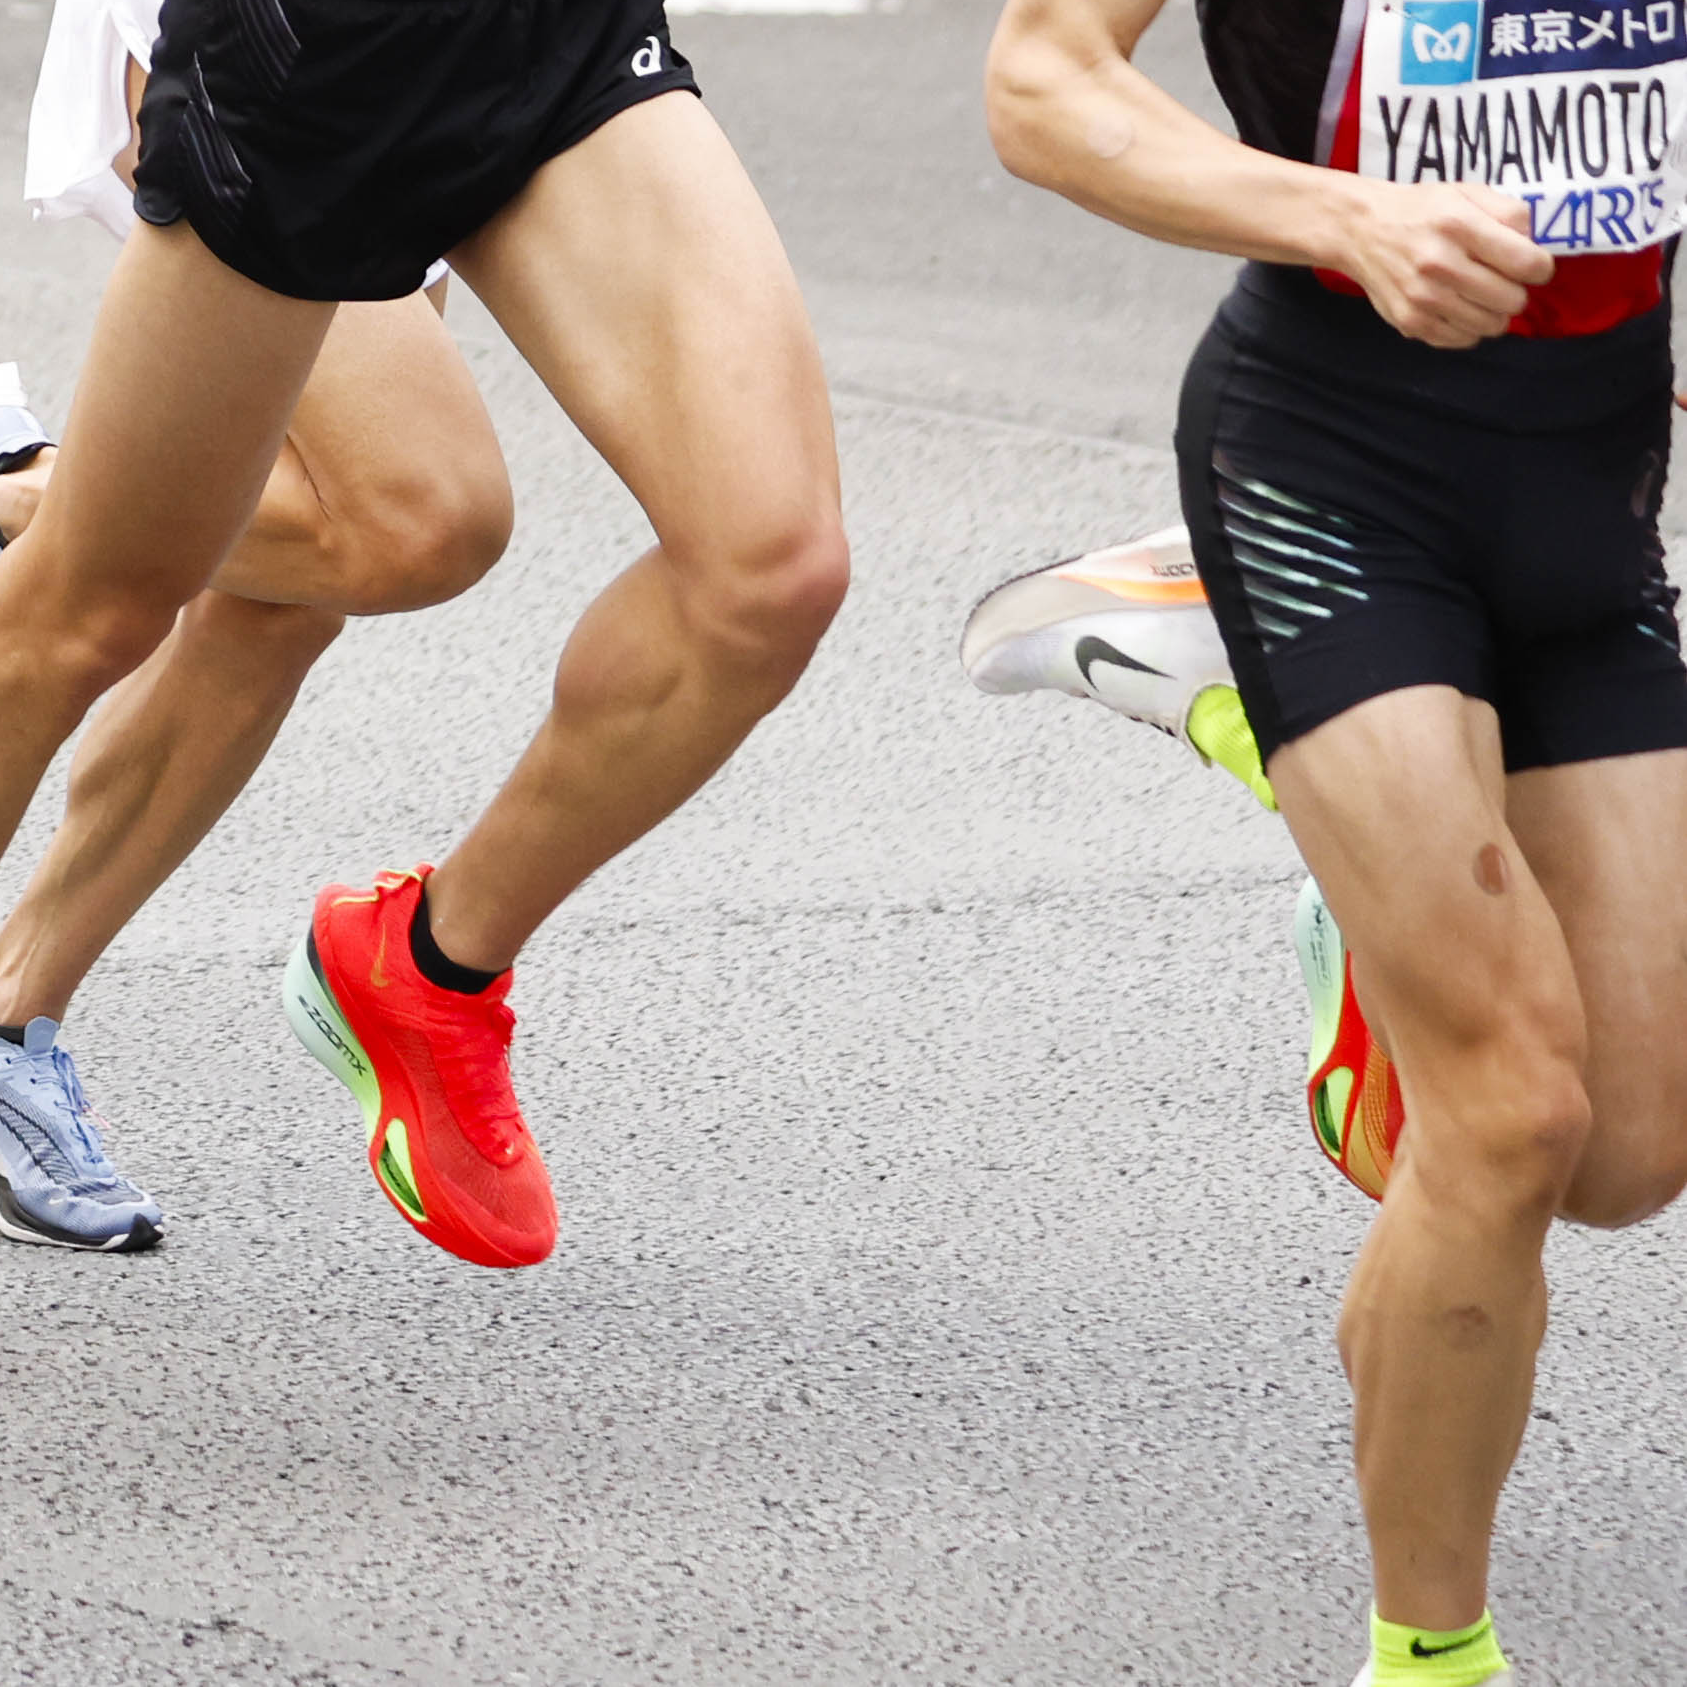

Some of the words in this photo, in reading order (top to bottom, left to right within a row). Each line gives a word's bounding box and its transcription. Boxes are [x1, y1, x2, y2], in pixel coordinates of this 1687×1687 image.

[1488, 1, 1676, 57] 東京メトロ
[1378, 78, 1669, 185] YAMAMOTO
